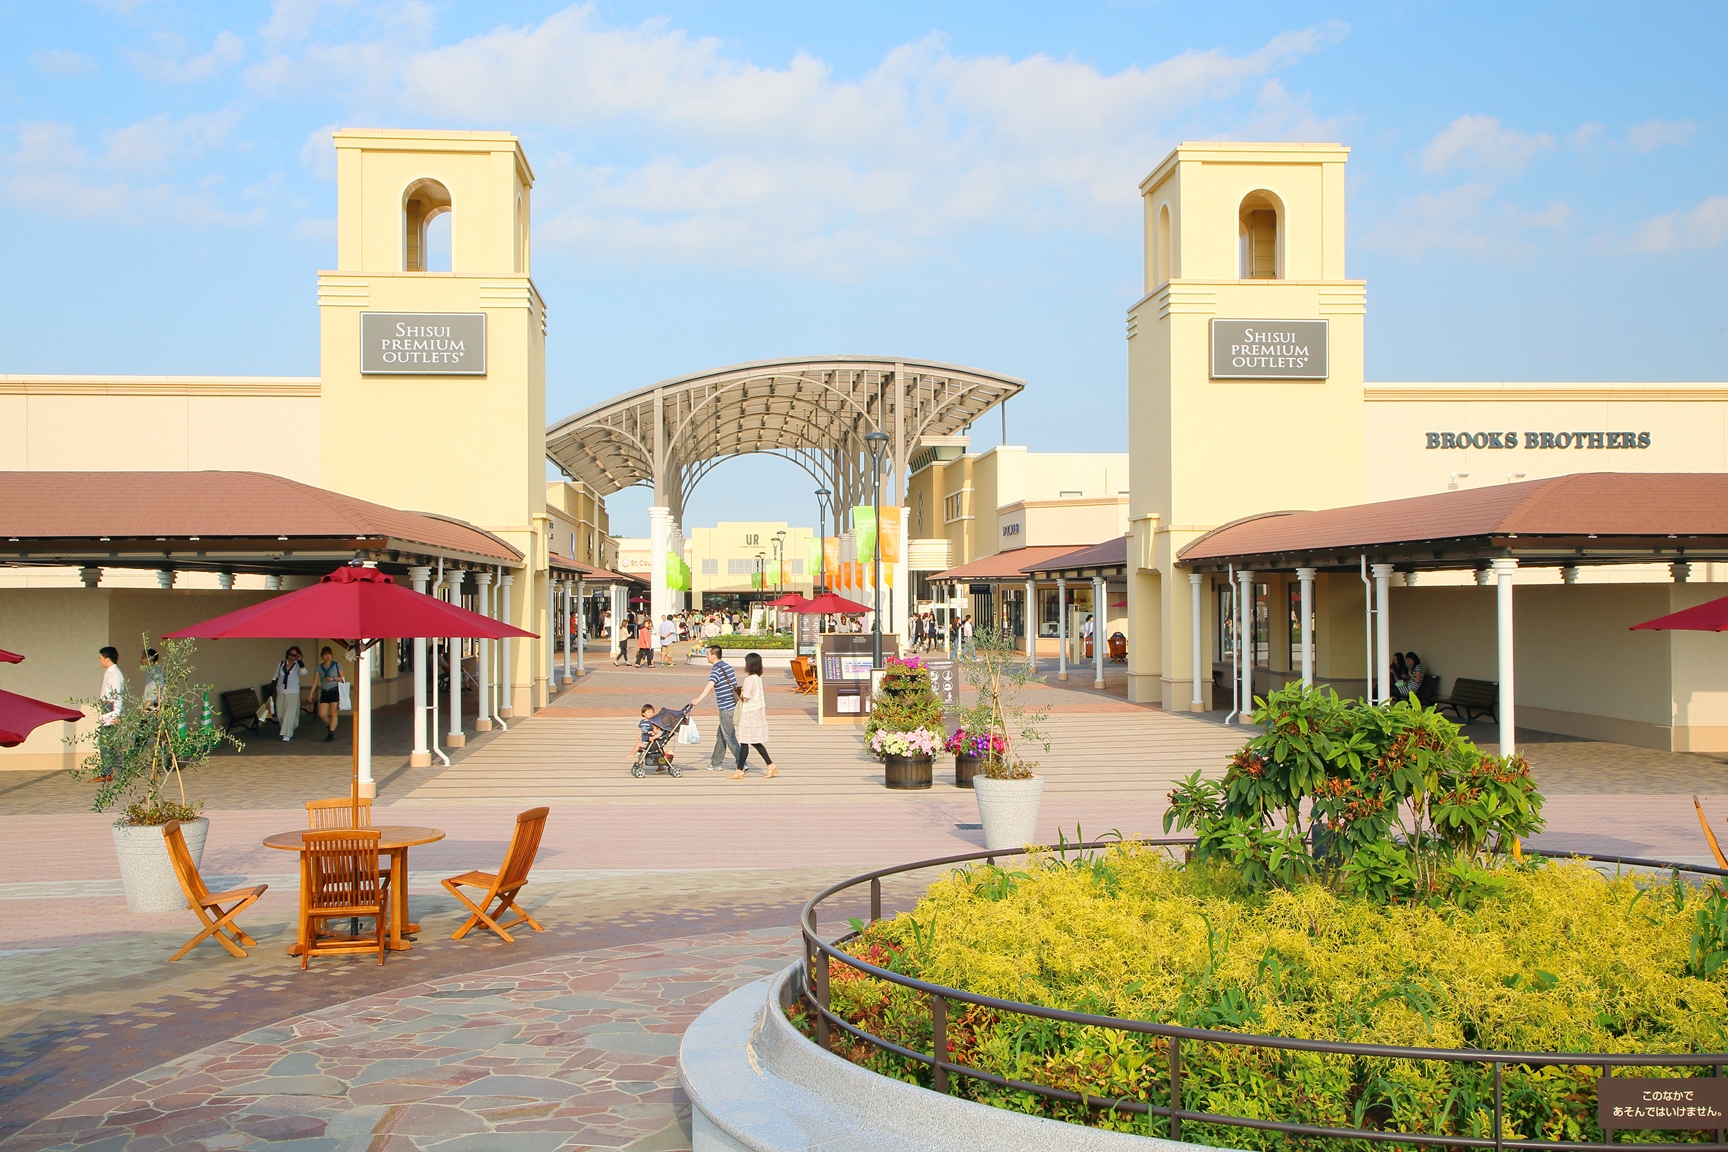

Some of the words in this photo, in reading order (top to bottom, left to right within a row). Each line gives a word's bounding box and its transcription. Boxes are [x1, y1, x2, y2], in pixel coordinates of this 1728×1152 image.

[381, 339, 466, 351] PREMIUM
[1231, 344, 1310, 356] PREMIUM
[1425, 431, 1519, 449] BROOKS
[1523, 431, 1652, 449] BROTHERS
[745, 533, 760, 546] UR
[1642, 1090, 1694, 1101] このなかで
[1612, 1106, 1722, 1117] あそんではいけません。
